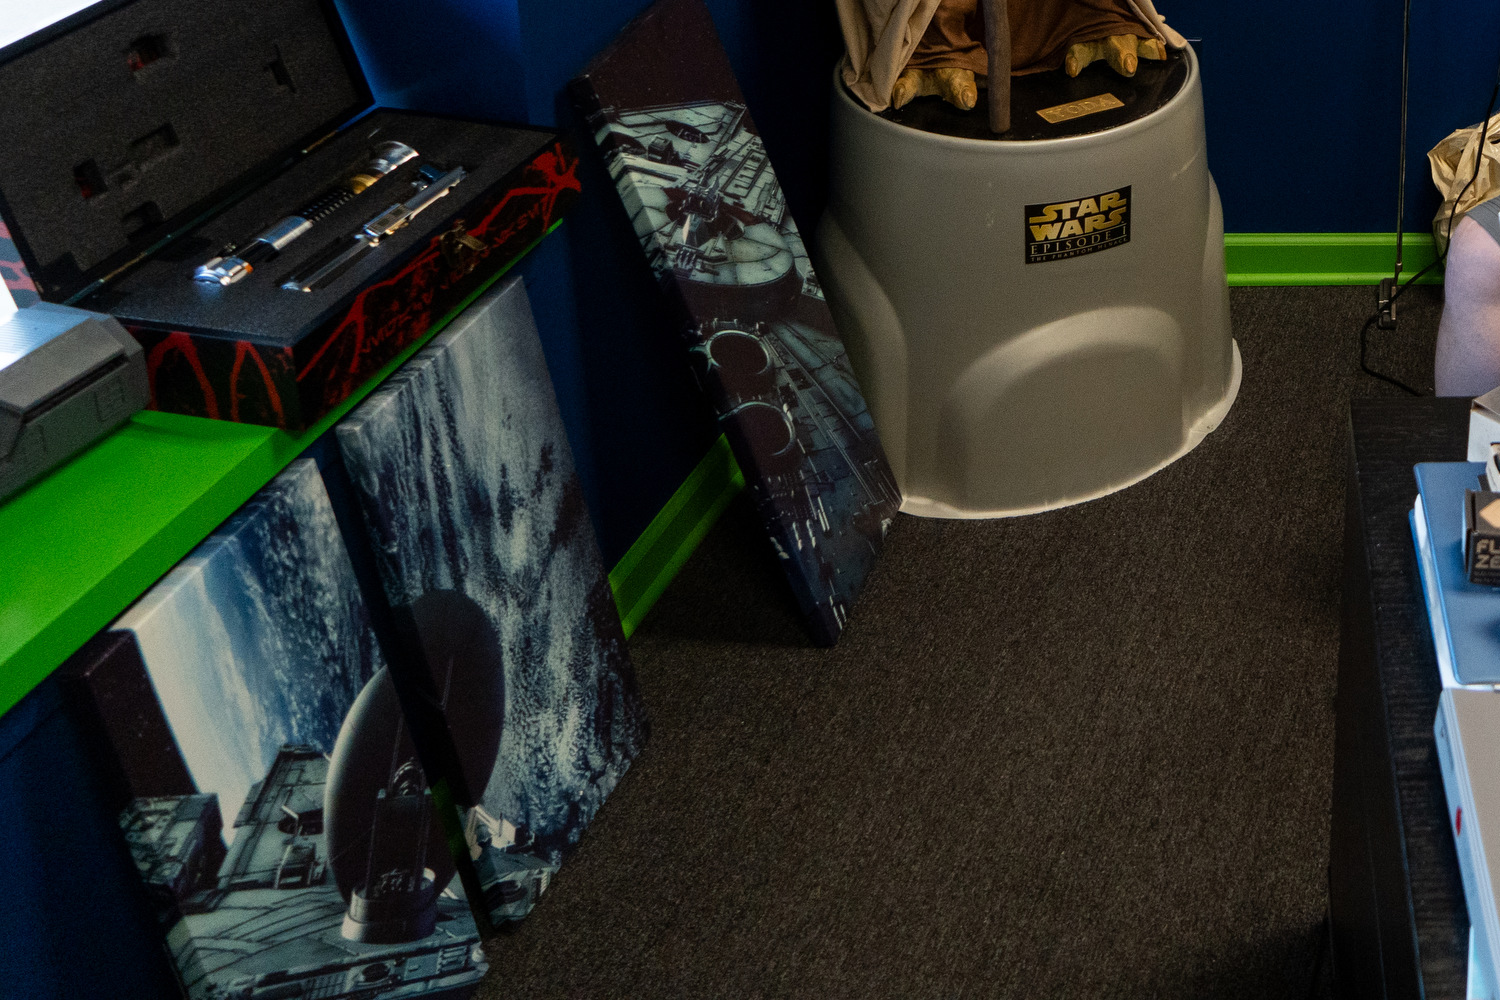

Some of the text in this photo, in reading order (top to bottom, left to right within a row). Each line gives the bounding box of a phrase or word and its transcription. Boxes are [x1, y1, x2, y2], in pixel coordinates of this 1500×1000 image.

[1046, 98, 1116, 118] YODA
[1029, 191, 1127, 224] STAR
[1029, 206, 1127, 241] WARS
[1031, 231, 1112, 255] EPISODE
[1052, 246, 1093, 260] PHANTOM
[1098, 237, 1128, 251] MENACE
